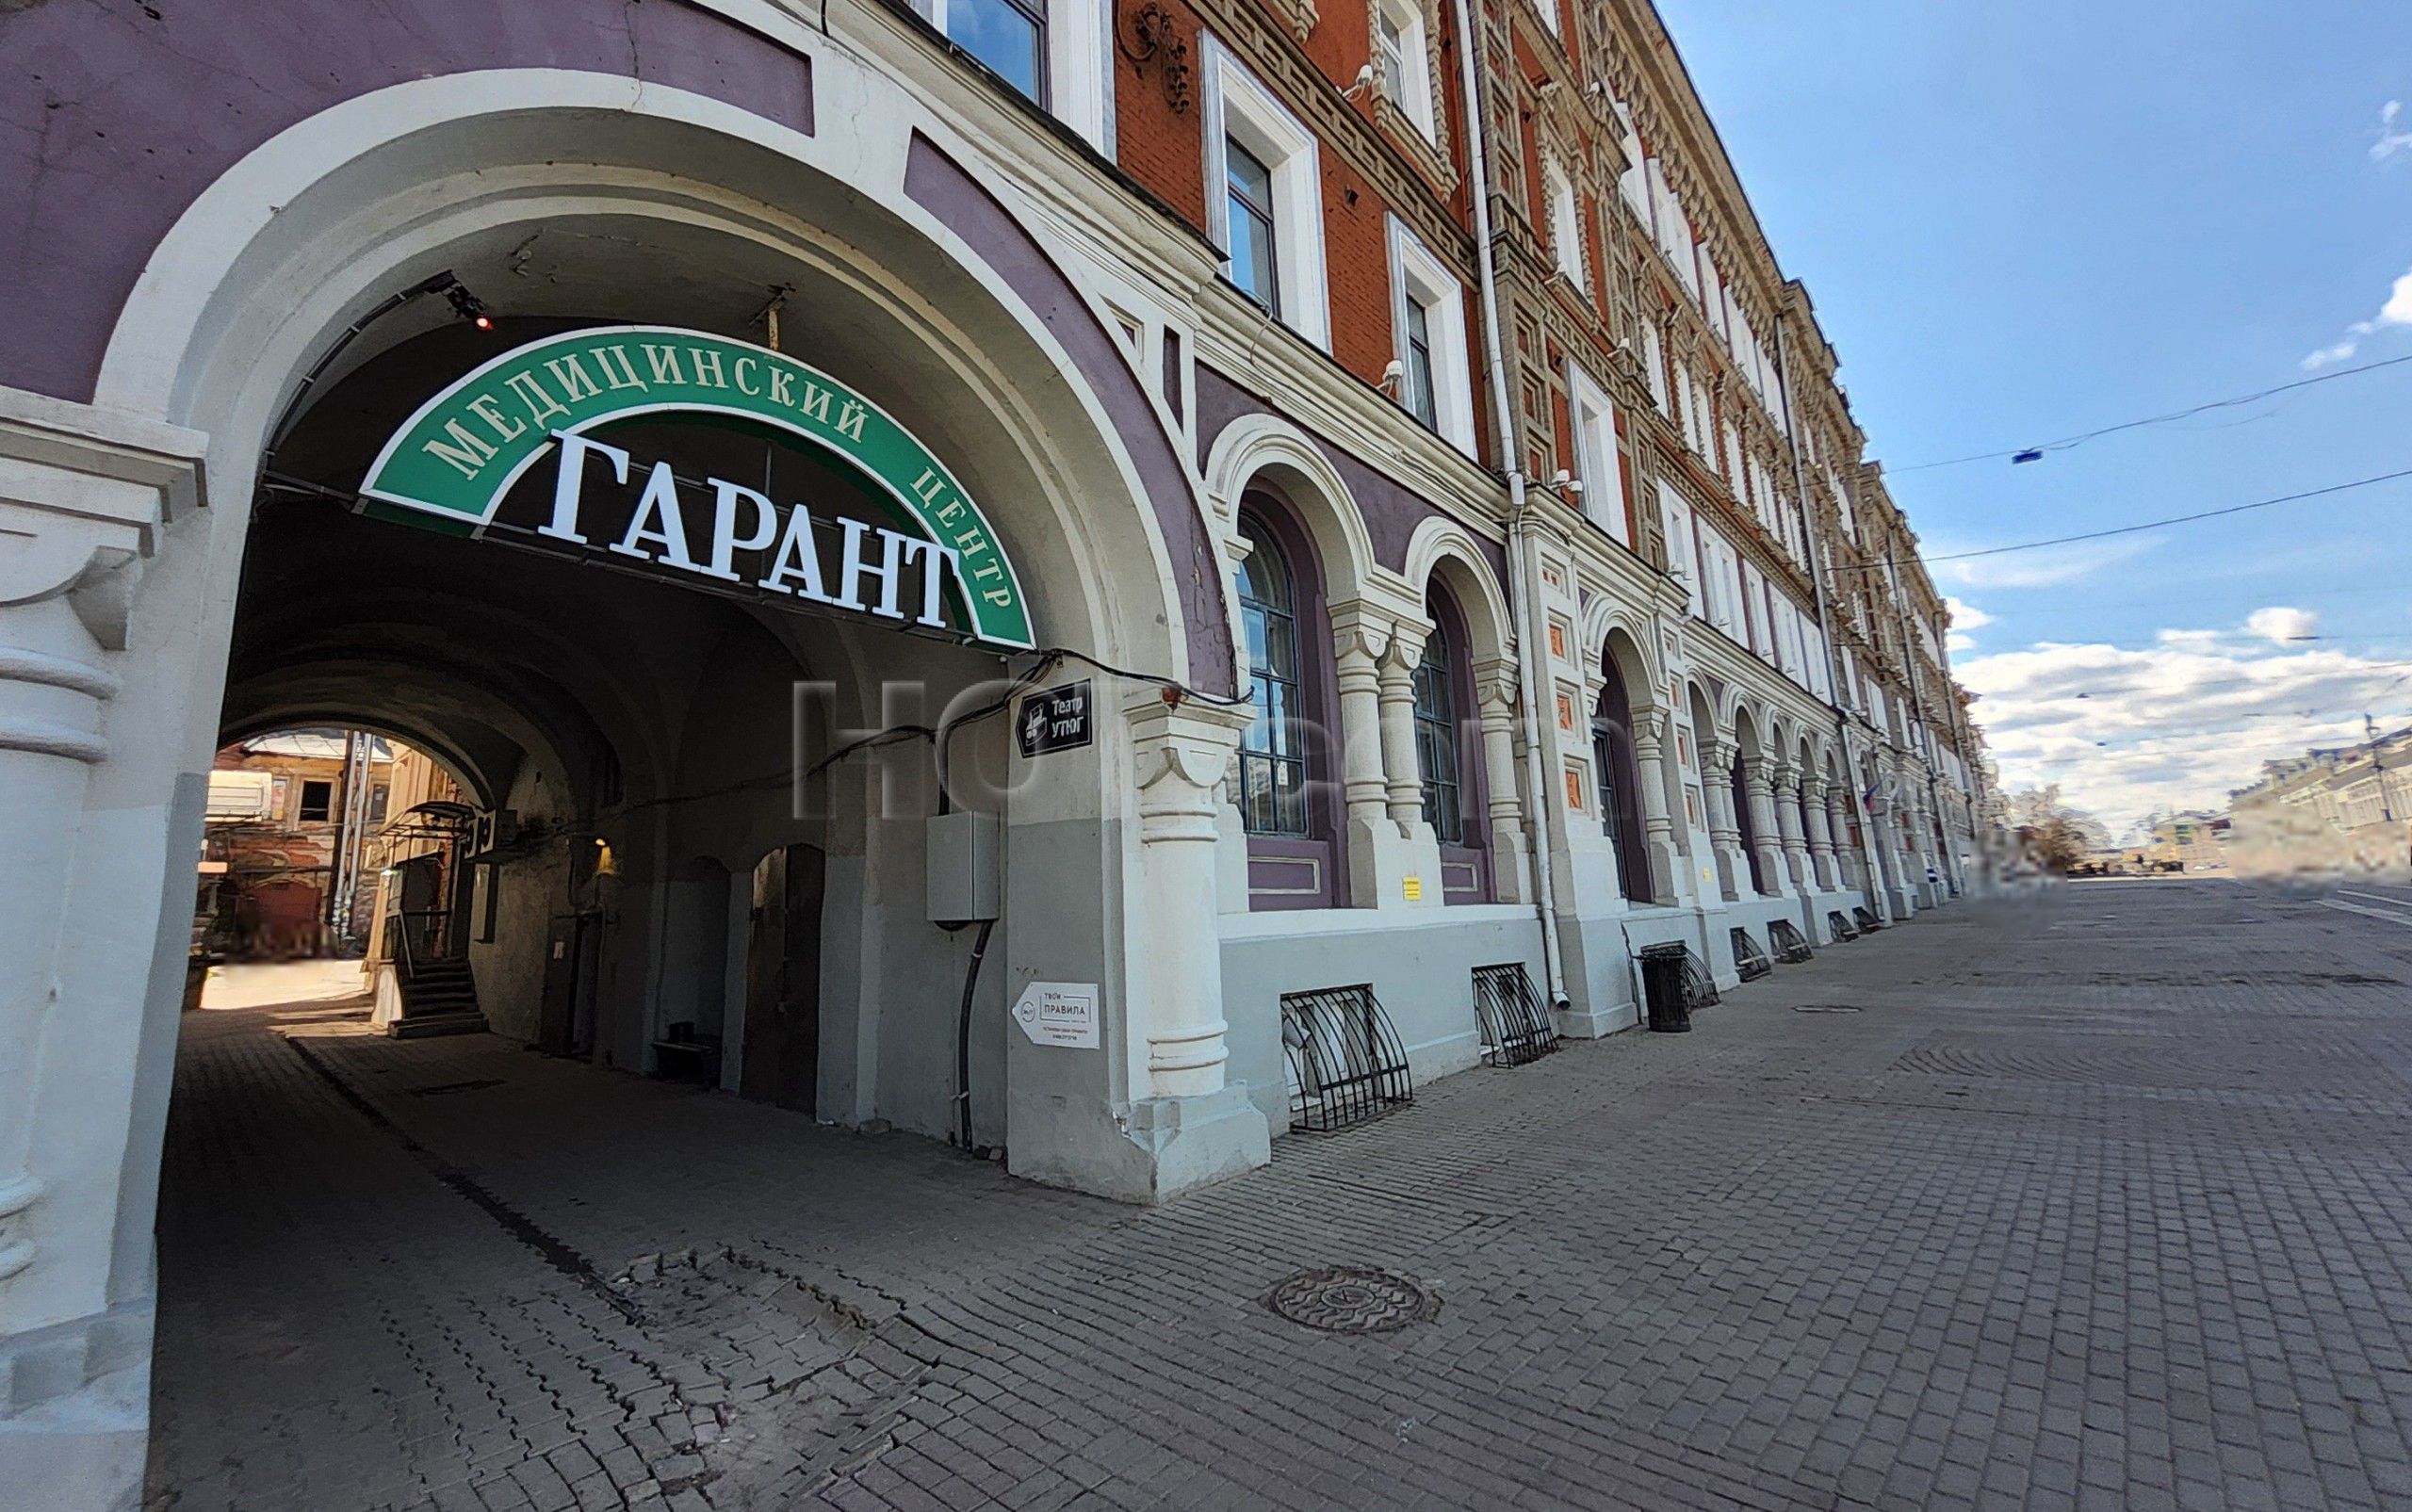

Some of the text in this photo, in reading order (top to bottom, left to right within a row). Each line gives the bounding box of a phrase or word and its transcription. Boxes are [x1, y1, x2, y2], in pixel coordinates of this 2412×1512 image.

[421, 344, 1011, 610] МЕДИЦИНСКИЙ ЦЕНТР
[538, 430, 959, 627] ГАРАНТ
[1051, 697, 1083, 716] Театр
[1044, 1004, 1085, 1015] ПРАВИЛА
